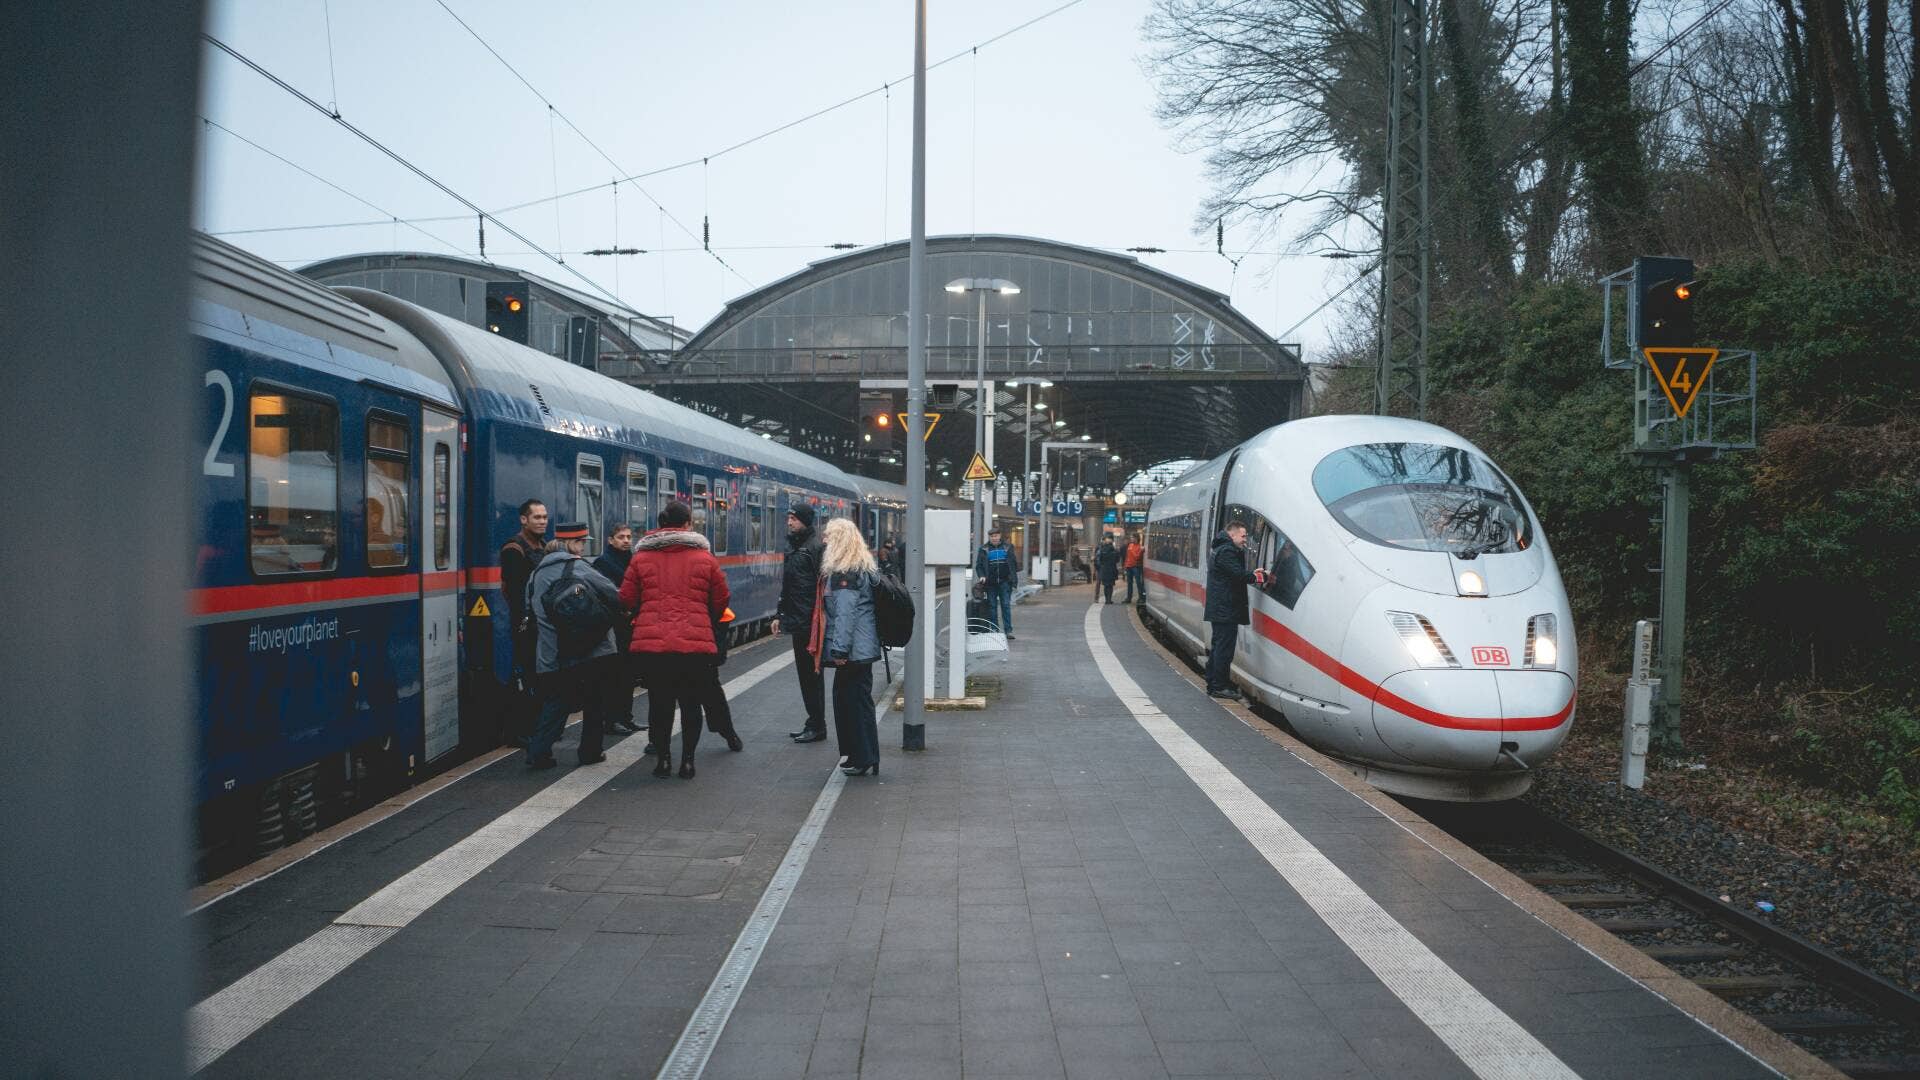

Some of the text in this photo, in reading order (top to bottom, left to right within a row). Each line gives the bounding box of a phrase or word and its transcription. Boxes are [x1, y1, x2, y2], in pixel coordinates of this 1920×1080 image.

[1670, 357, 1692, 393] 4
[203, 369, 235, 477] 2
[1057, 501, 1066, 513] C
[1074, 501, 1083, 513] 9
[249, 616, 339, 654] #loveyourplanet
[1476, 649, 1506, 663] DB
